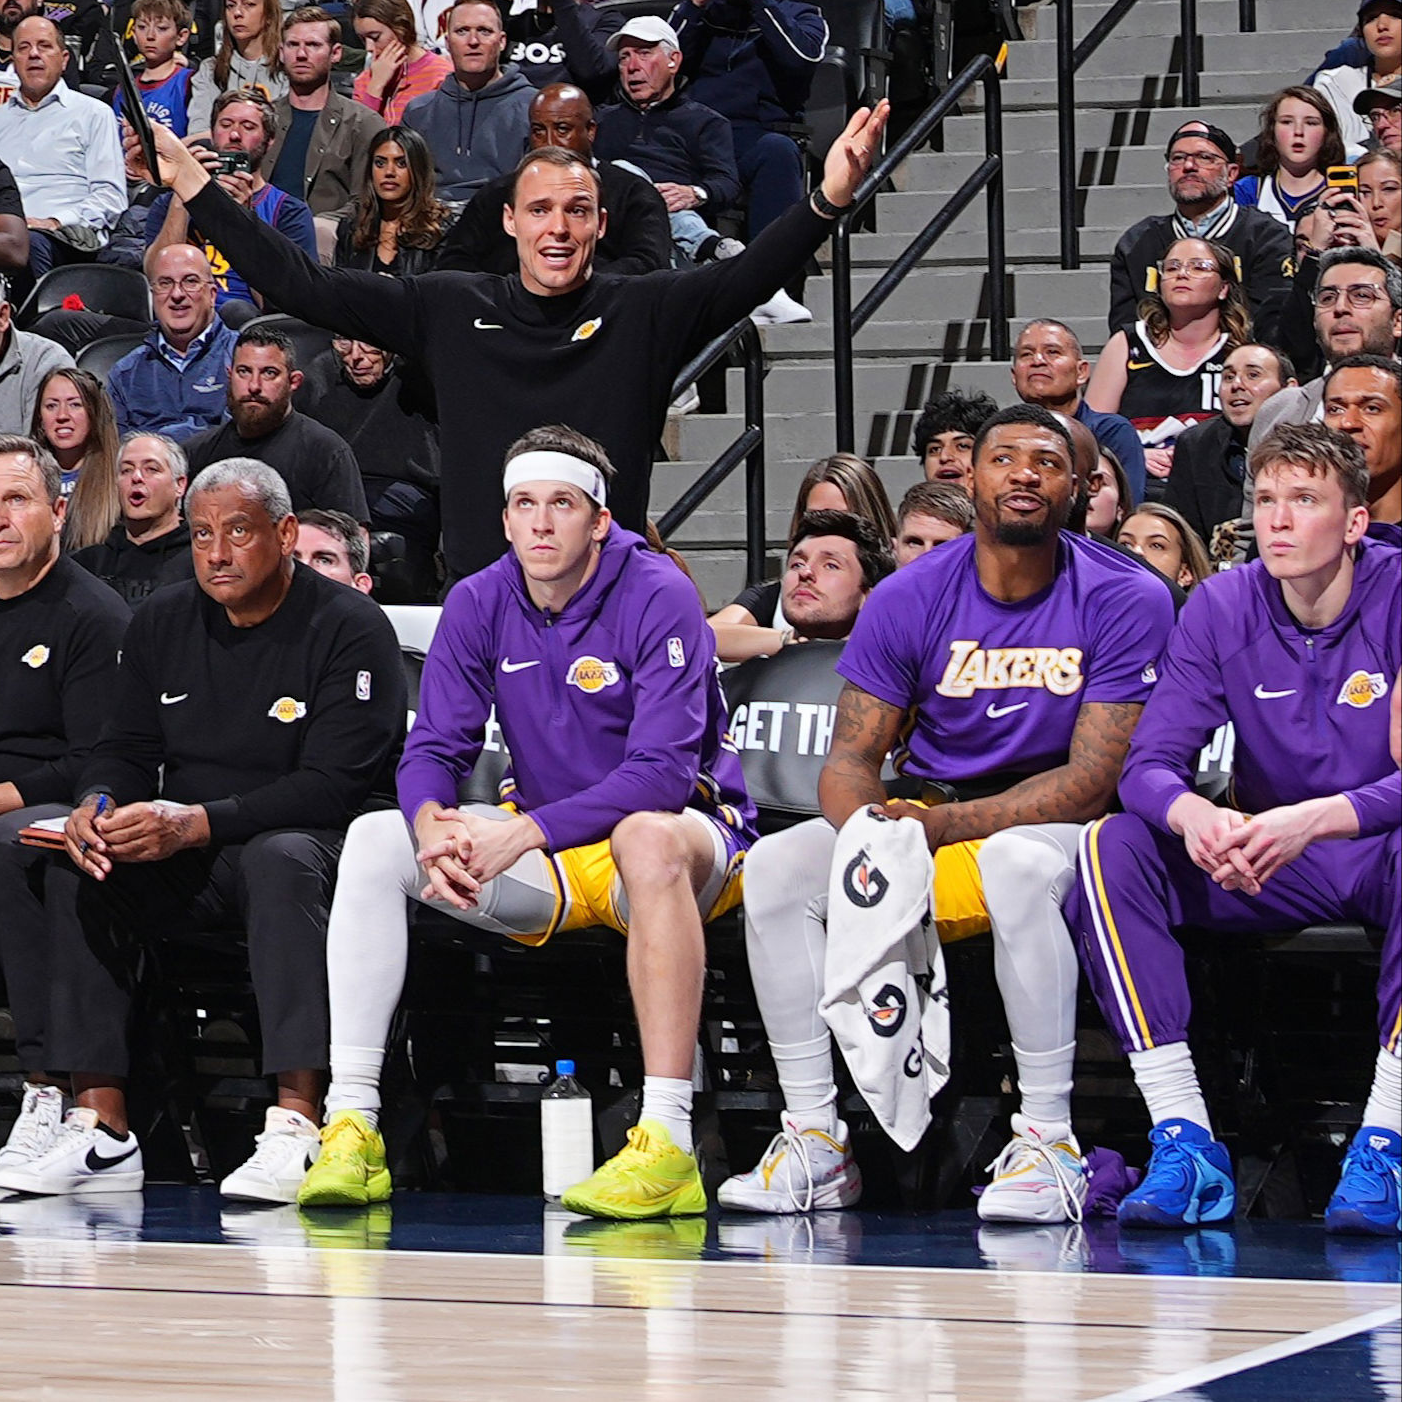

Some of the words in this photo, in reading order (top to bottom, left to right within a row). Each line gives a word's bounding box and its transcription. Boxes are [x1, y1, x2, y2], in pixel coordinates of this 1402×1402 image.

[935, 639, 1085, 699] LAKERS
[730, 701, 794, 754] GET
[795, 702, 838, 758] TH
